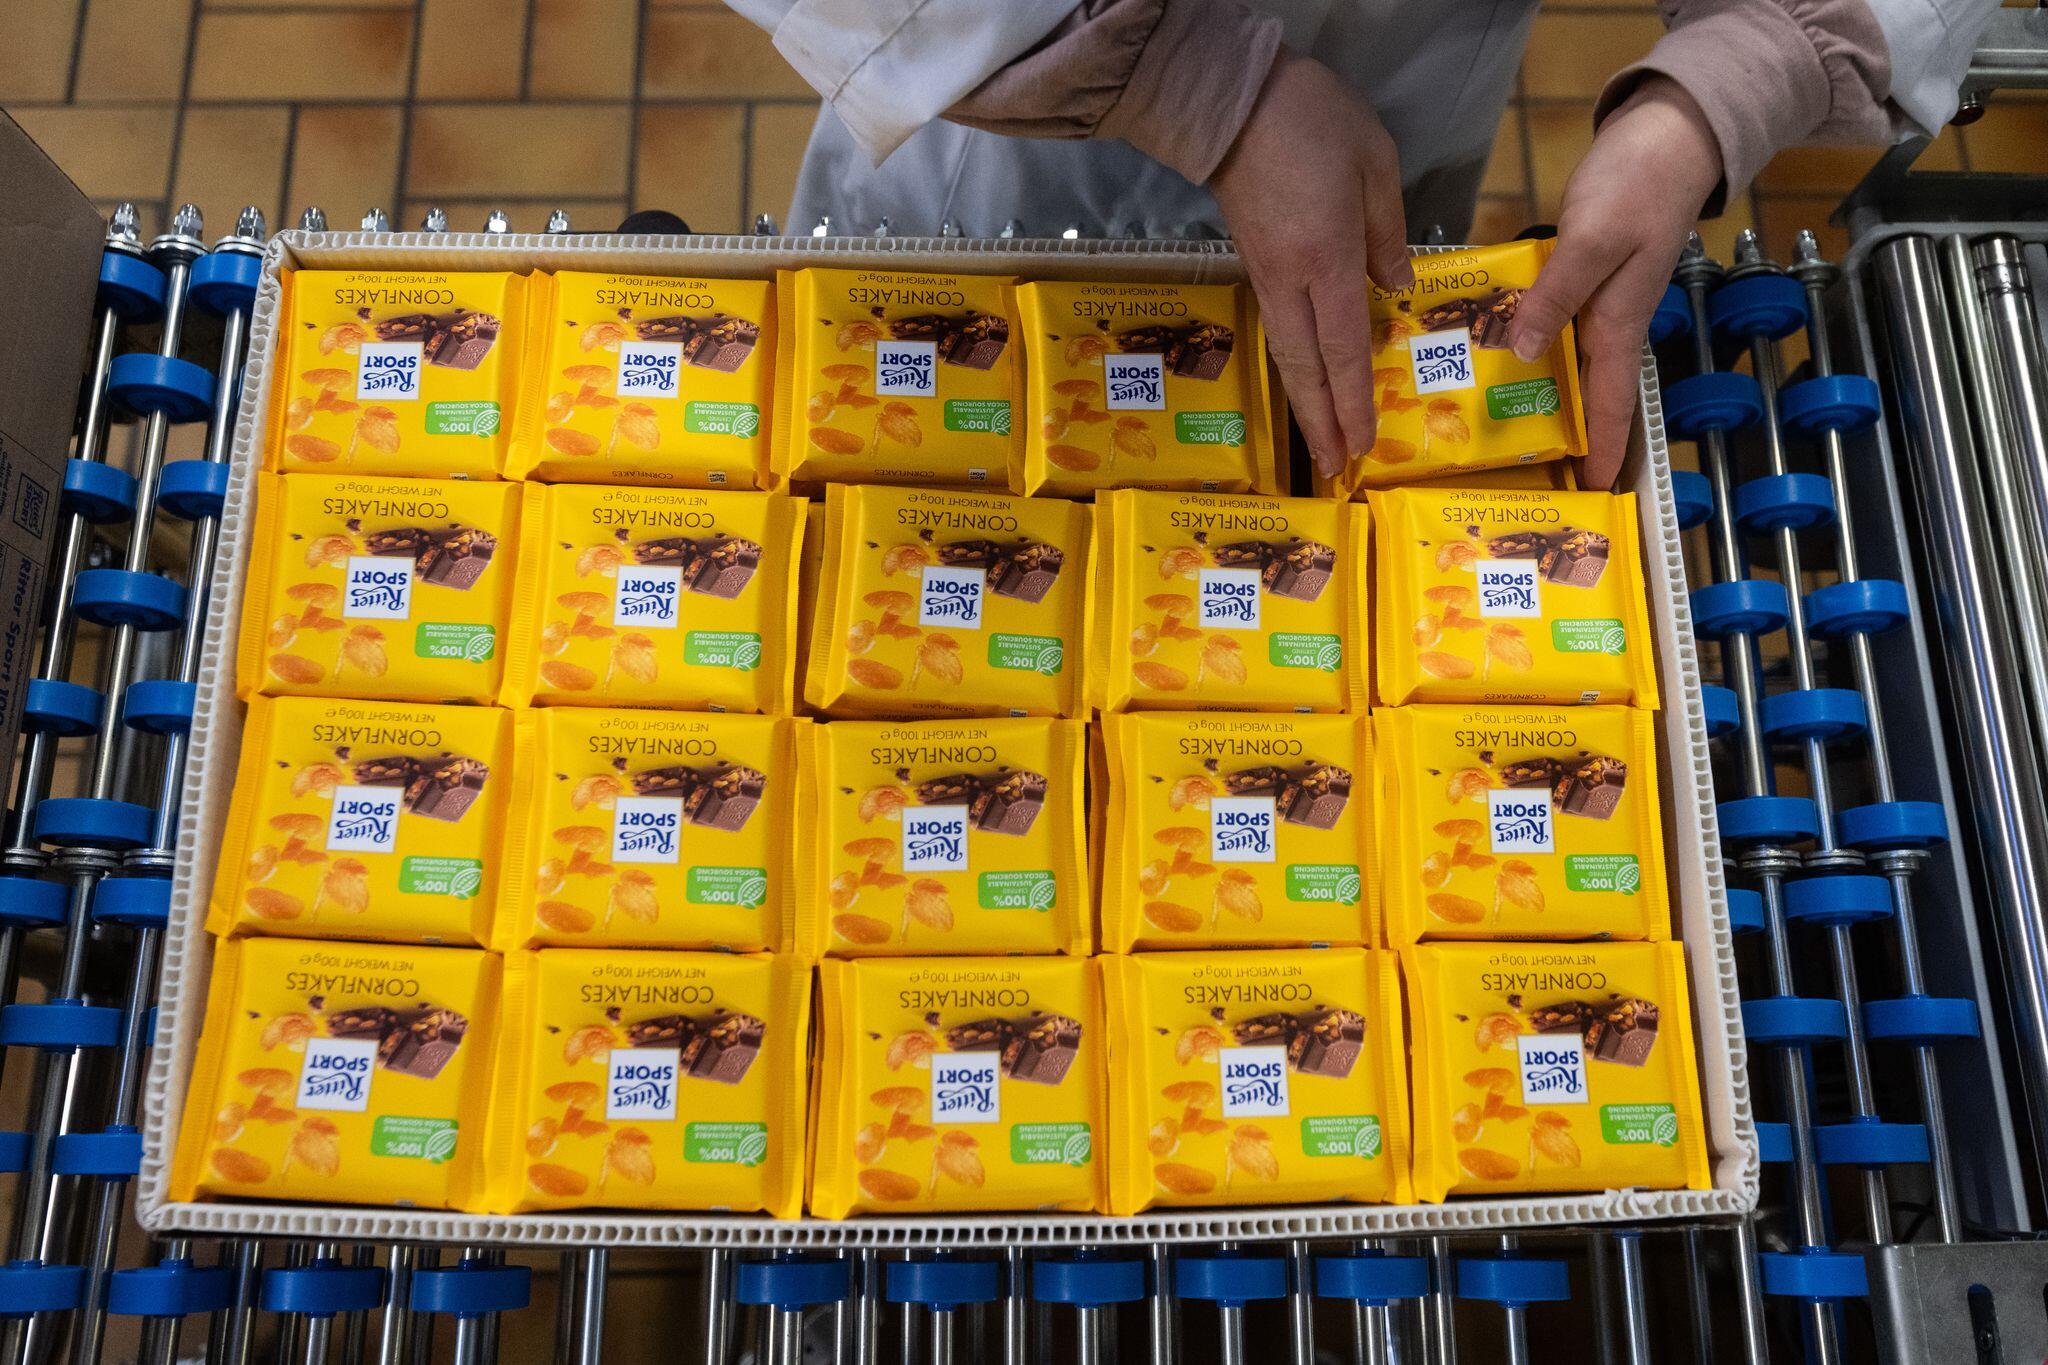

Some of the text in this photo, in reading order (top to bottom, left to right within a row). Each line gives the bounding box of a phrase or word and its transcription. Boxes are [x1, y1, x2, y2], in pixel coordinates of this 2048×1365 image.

[1417, 256, 1478, 272] NET WEIGHT
[384, 275, 426, 283] WEIGHT
[428, 275, 446, 283] NET
[645, 278, 686, 287] WEIGHT
[688, 281, 707, 289] NET
[895, 275, 936, 284] WEIGHT
[938, 277, 956, 286] NET
[334, 288, 453, 305] CORNFLAKES
[848, 287, 964, 306] CORNFLAKES
[1117, 286, 1158, 295] WEIGHT
[595, 289, 713, 309] CORNFLAKES
[1072, 300, 1187, 317] CORNFLAKES
[880, 353, 931, 366] SPORT
[1416, 343, 1466, 362] SPORT
[364, 356, 416, 367] SPORT
[624, 354, 676, 367] SPORT
[622, 366, 675, 390] Ritter
[880, 366, 932, 389] Ritter
[1108, 367, 1159, 378] SPORT
[1418, 358, 1470, 385] Ritter
[363, 369, 415, 392] Ritter
[1528, 379, 1550, 387] COCOA
[1109, 380, 1162, 403] Ritter
[1495, 389, 1537, 400] SUSTAINABLE
[1502, 402, 1533, 416] 100%
[438, 421, 471, 433] 100%
[697, 420, 730, 433] 100%
[957, 419, 989, 430] 100%
[1188, 431, 1221, 442] 100%
[612, 471, 674, 480] CORNFLAKES
[375, 483, 420, 495] WEIGHT
[422, 486, 442, 496] NET
[21, 482, 33, 525] SPORT
[643, 493, 686, 504] WEIGHT
[688, 496, 707, 506] NET
[947, 496, 989, 508] WEIGHT
[1217, 498, 1259, 508] WEIGHT
[1487, 492, 1529, 502] WEIGHT
[1530, 494, 1549, 503] NET
[322, 497, 449, 519] CORNFLAKES
[991, 500, 1010, 510] NET
[1260, 501, 1280, 509] NET
[591, 507, 714, 528] CORNFLAKES
[897, 507, 1017, 532] CORNFLAKES
[1170, 511, 1288, 532] CORNFLAKES
[1441, 506, 1560, 523] CORNFLAKES
[351, 570, 407, 584] SPORT
[1480, 573, 1533, 585] SPORT
[13, 558, 32, 617] Ritter
[621, 579, 675, 593] SPORT
[926, 579, 979, 595] SPORT
[1203, 582, 1255, 596] SPORT
[350, 584, 406, 611] Ritter
[1482, 586, 1537, 609] Ritter
[620, 593, 674, 619] Ritter
[925, 593, 978, 621] Ritter
[1203, 595, 1256, 621] Ritter
[2, 621, 20, 682] Sport
[429, 644, 464, 657] 100%
[1566, 639, 1600, 651] 100%
[698, 652, 731, 665] 100%
[1001, 654, 1034, 669] 100%
[1282, 653, 1315, 666] 100%
[641, 720, 686, 730] WEIGHT
[1501, 713, 1545, 723] WEIGHT
[1546, 714, 1567, 723] NET
[689, 722, 709, 731] NET
[1227, 721, 1272, 731] WEIGHT
[1273, 722, 1293, 731] NET
[311, 724, 441, 747] CORNFLAKES
[920, 729, 965, 739] WEIGHT
[967, 729, 987, 738] NET
[1454, 729, 1577, 748] CORNFLAKES
[588, 735, 716, 756] CORNFLAKES
[1178, 737, 1303, 756] CORNFLAKES
[870, 744, 997, 766] CORNFLAKES
[337, 801, 395, 816] SPORT
[1492, 804, 1547, 817] SPORT
[620, 812, 676, 826] SPORT
[1215, 812, 1270, 825] SPORT
[334, 815, 393, 843] Ritter
[907, 821, 962, 835] SPORT
[1494, 818, 1550, 844] Ritter
[619, 827, 675, 854] Ritter
[1216, 827, 1271, 853] Ritter
[907, 835, 964, 863] Ritter
[412, 878, 449, 893] 100%
[1579, 876, 1614, 889] 100%
[700, 889, 735, 902] 100%
[1300, 886, 1334, 899] 100%
[992, 893, 1027, 907] 100%
[1528, 954, 1574, 965] WEIGHT
[1575, 954, 1596, 964] NET
[1233, 965, 1280, 977] WEIGHT
[1281, 966, 1302, 976] NET
[284, 971, 420, 997] CORNFLAKES
[1480, 970, 1607, 992] CORNFLAKES
[580, 984, 714, 1004] CORNFLAKES
[899, 987, 1030, 1009] CORNFLAKES
[1183, 981, 1313, 1005] CORNFLAKES
[308, 1054, 369, 1071] SPORT
[1523, 1050, 1579, 1065] SPORT
[614, 1065, 672, 1079] SPORT
[936, 1068, 994, 1084] SPORT
[1224, 1062, 1282, 1078] SPORT
[304, 1070, 366, 1101] Ritter
[1525, 1066, 1583, 1094] Ritter
[613, 1081, 671, 1110] Ritter
[936, 1084, 995, 1114] Ritter
[1225, 1078, 1285, 1108] Ritter
[1615, 1127, 1652, 1141] 100%
[699, 1146, 735, 1160] 100%
[1025, 1147, 1062, 1161] 100%
[1316, 1140, 1353, 1154] 100%
